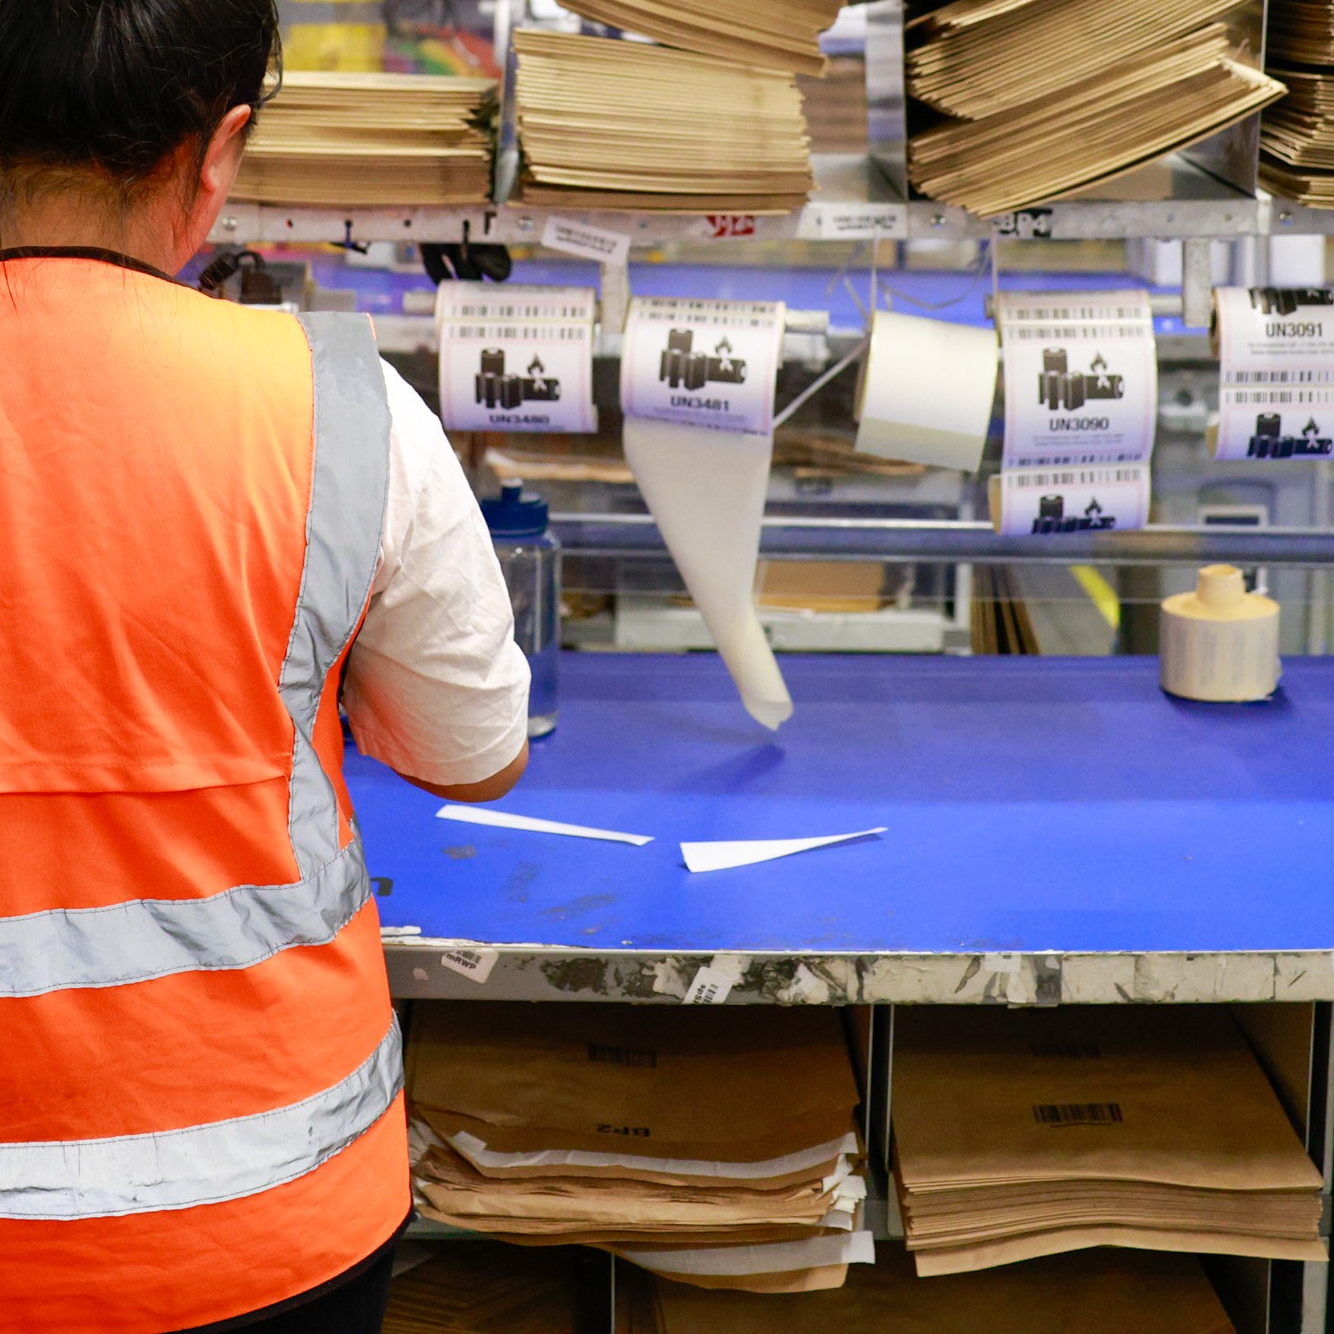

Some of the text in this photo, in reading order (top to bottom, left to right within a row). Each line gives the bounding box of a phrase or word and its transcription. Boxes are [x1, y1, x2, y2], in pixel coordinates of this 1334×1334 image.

[1265, 322, 1323, 338] UN3091
[670, 395, 730, 412] UN3481
[1049, 417, 1110, 431] UN3090
[446, 953, 477, 970] mRWP
[596, 1123, 651, 1138] BP2
